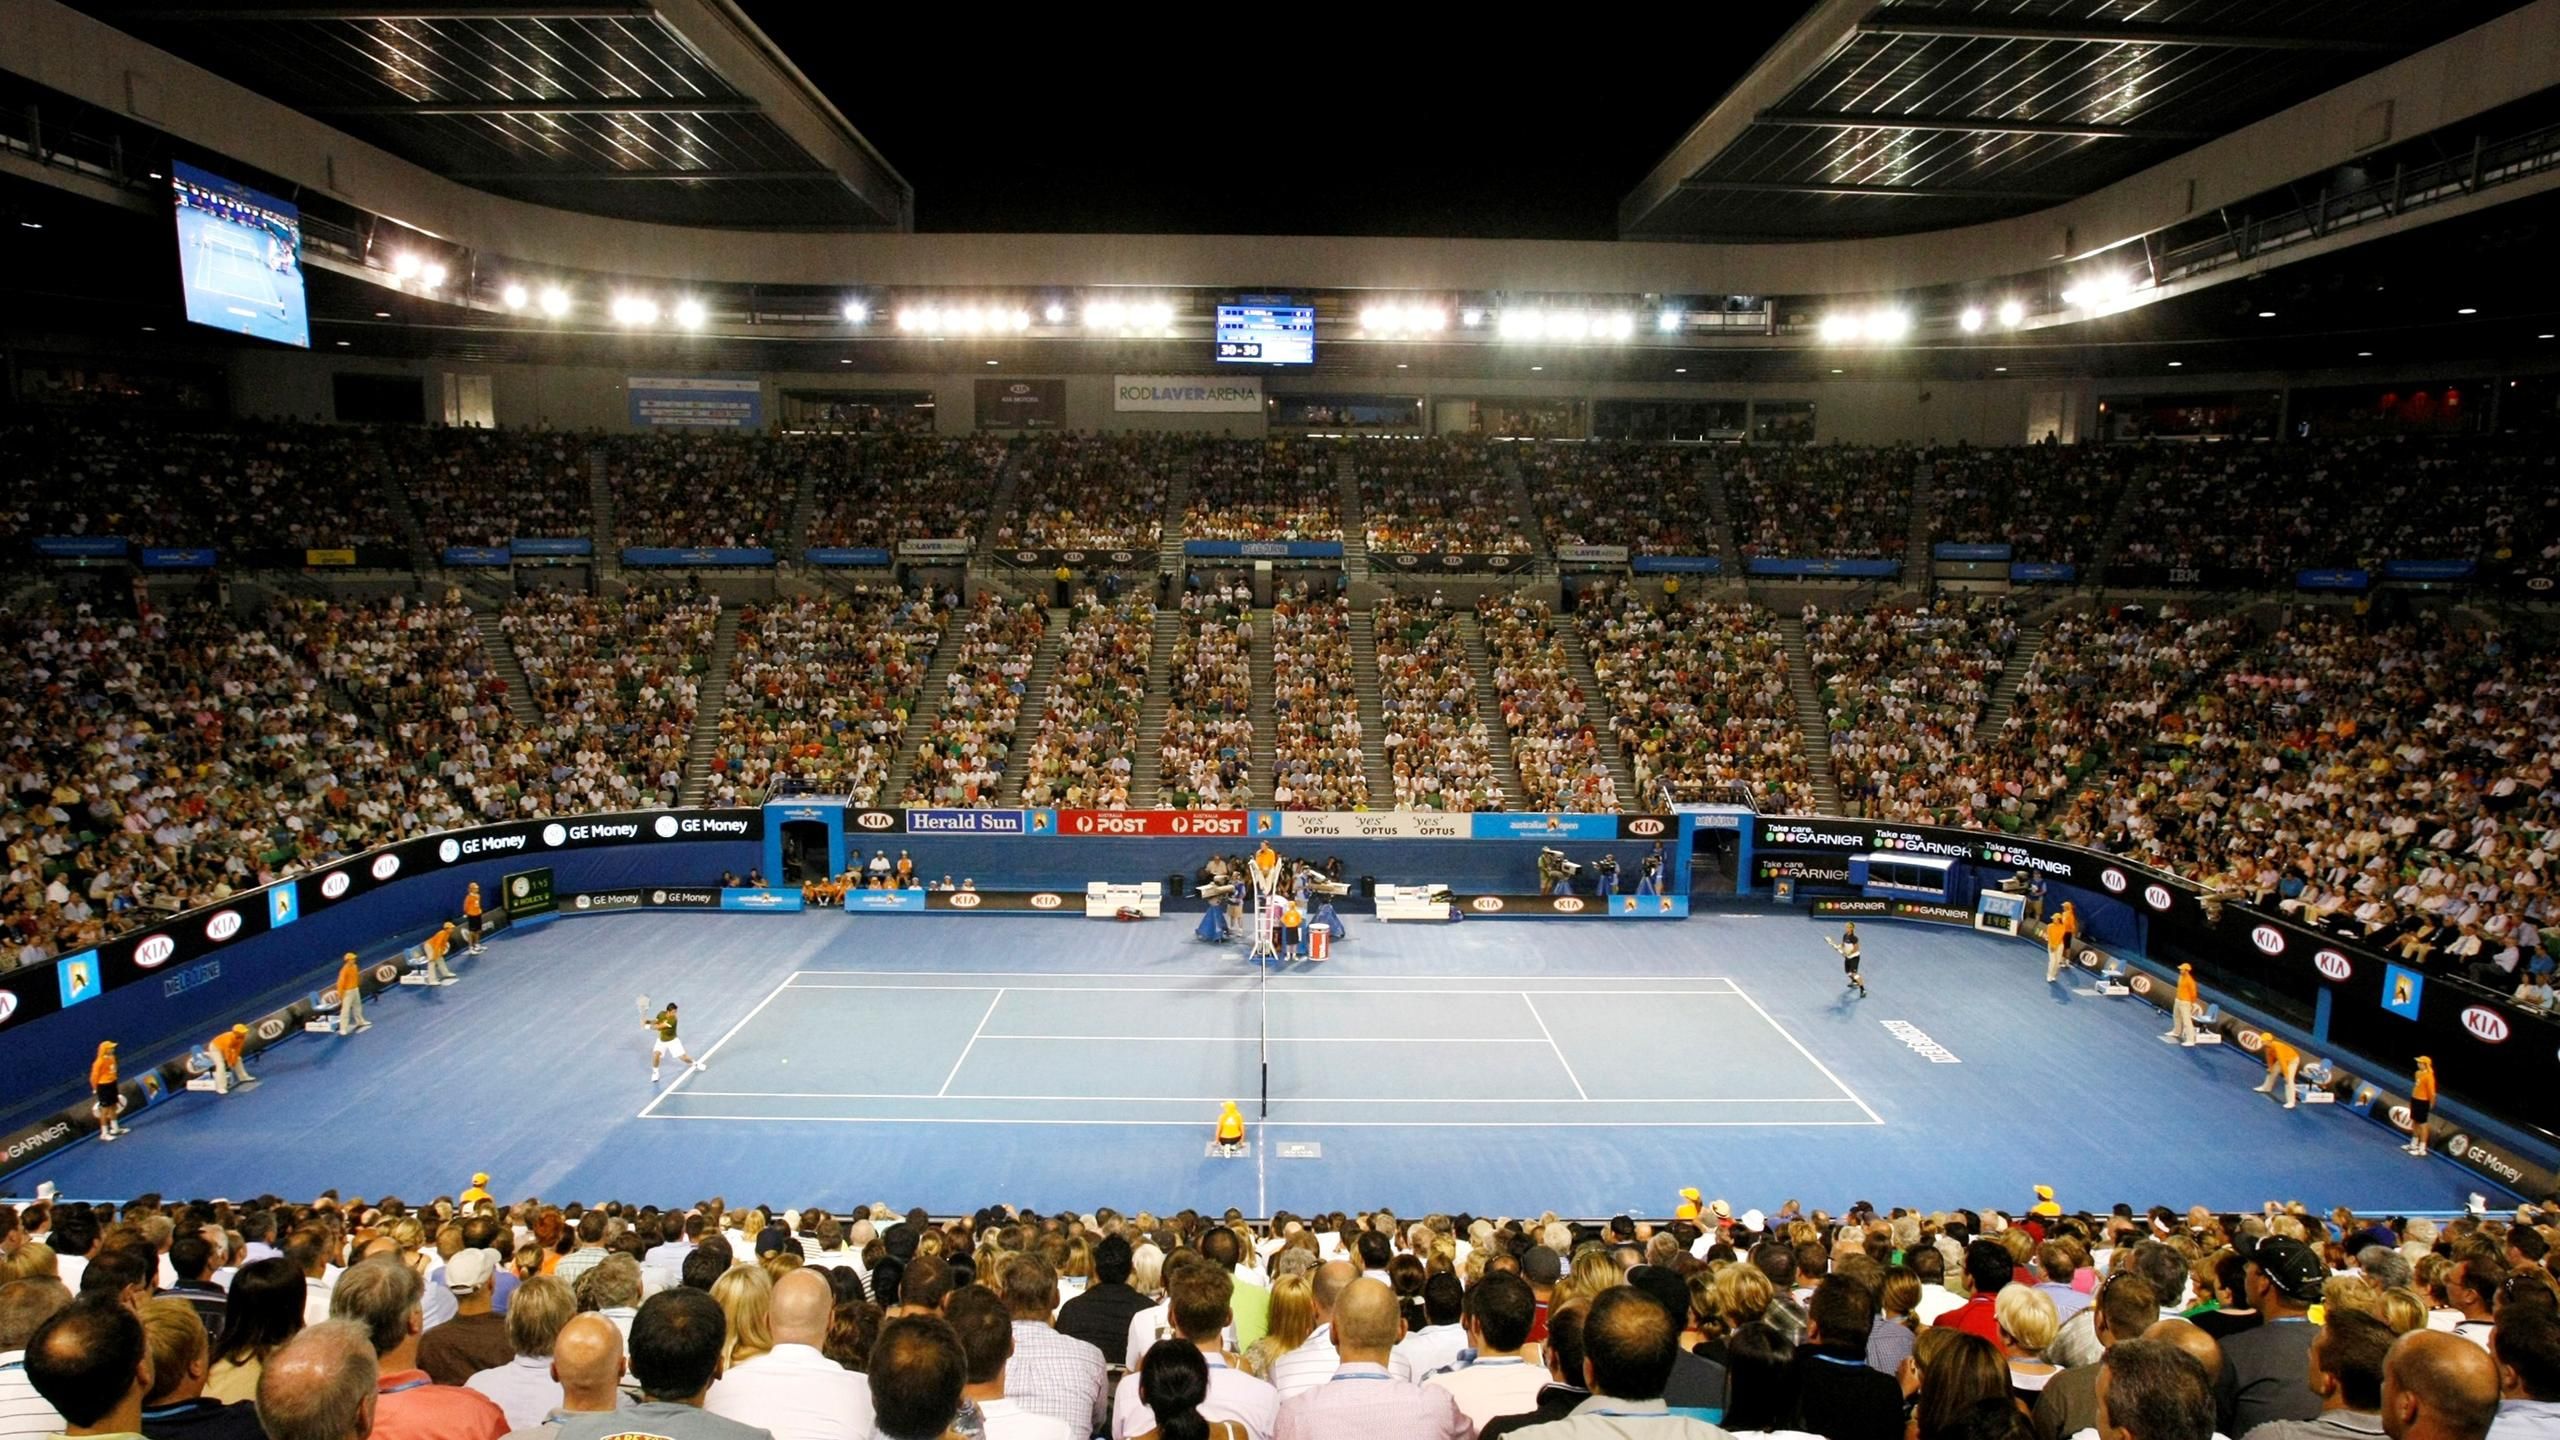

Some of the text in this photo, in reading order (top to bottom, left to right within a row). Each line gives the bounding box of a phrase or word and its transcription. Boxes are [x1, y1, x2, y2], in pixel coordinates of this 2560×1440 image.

[2168, 568, 2200, 582] IBM
[681, 819, 748, 834] GE Money
[863, 815, 889, 826] KIA
[913, 813, 1017, 829] Herald Sun
[1097, 818, 1147, 832] POST
[1193, 818, 1242, 833] POST
[1510, 820, 1547, 829] australian
[569, 824, 638, 839] GE Money
[1362, 827, 1397, 835] OPTUS
[1420, 827, 1455, 835] OPTUS
[1634, 822, 1659, 832] KIA
[1767, 824, 1789, 832] Take
[1876, 830, 1898, 839] Take
[462, 835, 526, 853] GE Money
[1985, 842, 2006, 852] Take
[593, 894, 638, 905] GE Money
[668, 893, 711, 903] GE Money
[1985, 898, 2013, 915] IBM
[2468, 1010, 2500, 1038] KIA
[2467, 1146, 2523, 1184] GE Money
